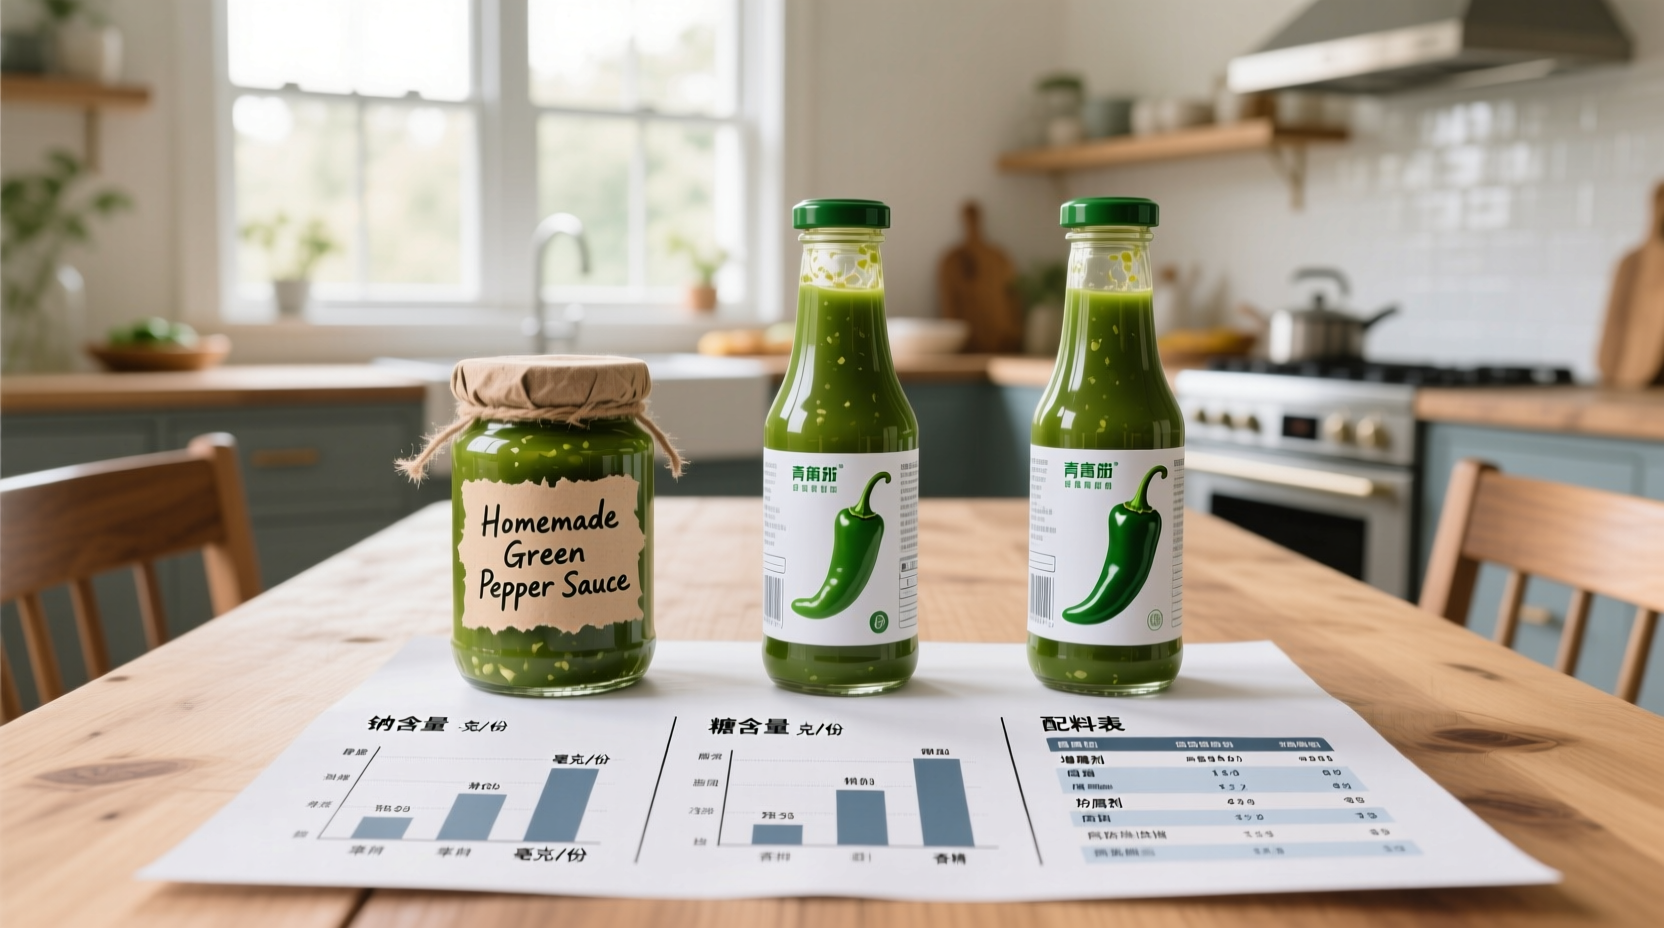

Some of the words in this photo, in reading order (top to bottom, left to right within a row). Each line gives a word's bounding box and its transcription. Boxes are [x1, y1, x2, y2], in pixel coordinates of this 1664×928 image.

[481, 498, 619, 538] Homemade
[504, 539, 585, 569] Green
[479, 568, 555, 612] Pepper
[562, 570, 631, 598] Sauce
[708, 717, 790, 736] 糖含量
[1040, 715, 1126, 732] 配料表
